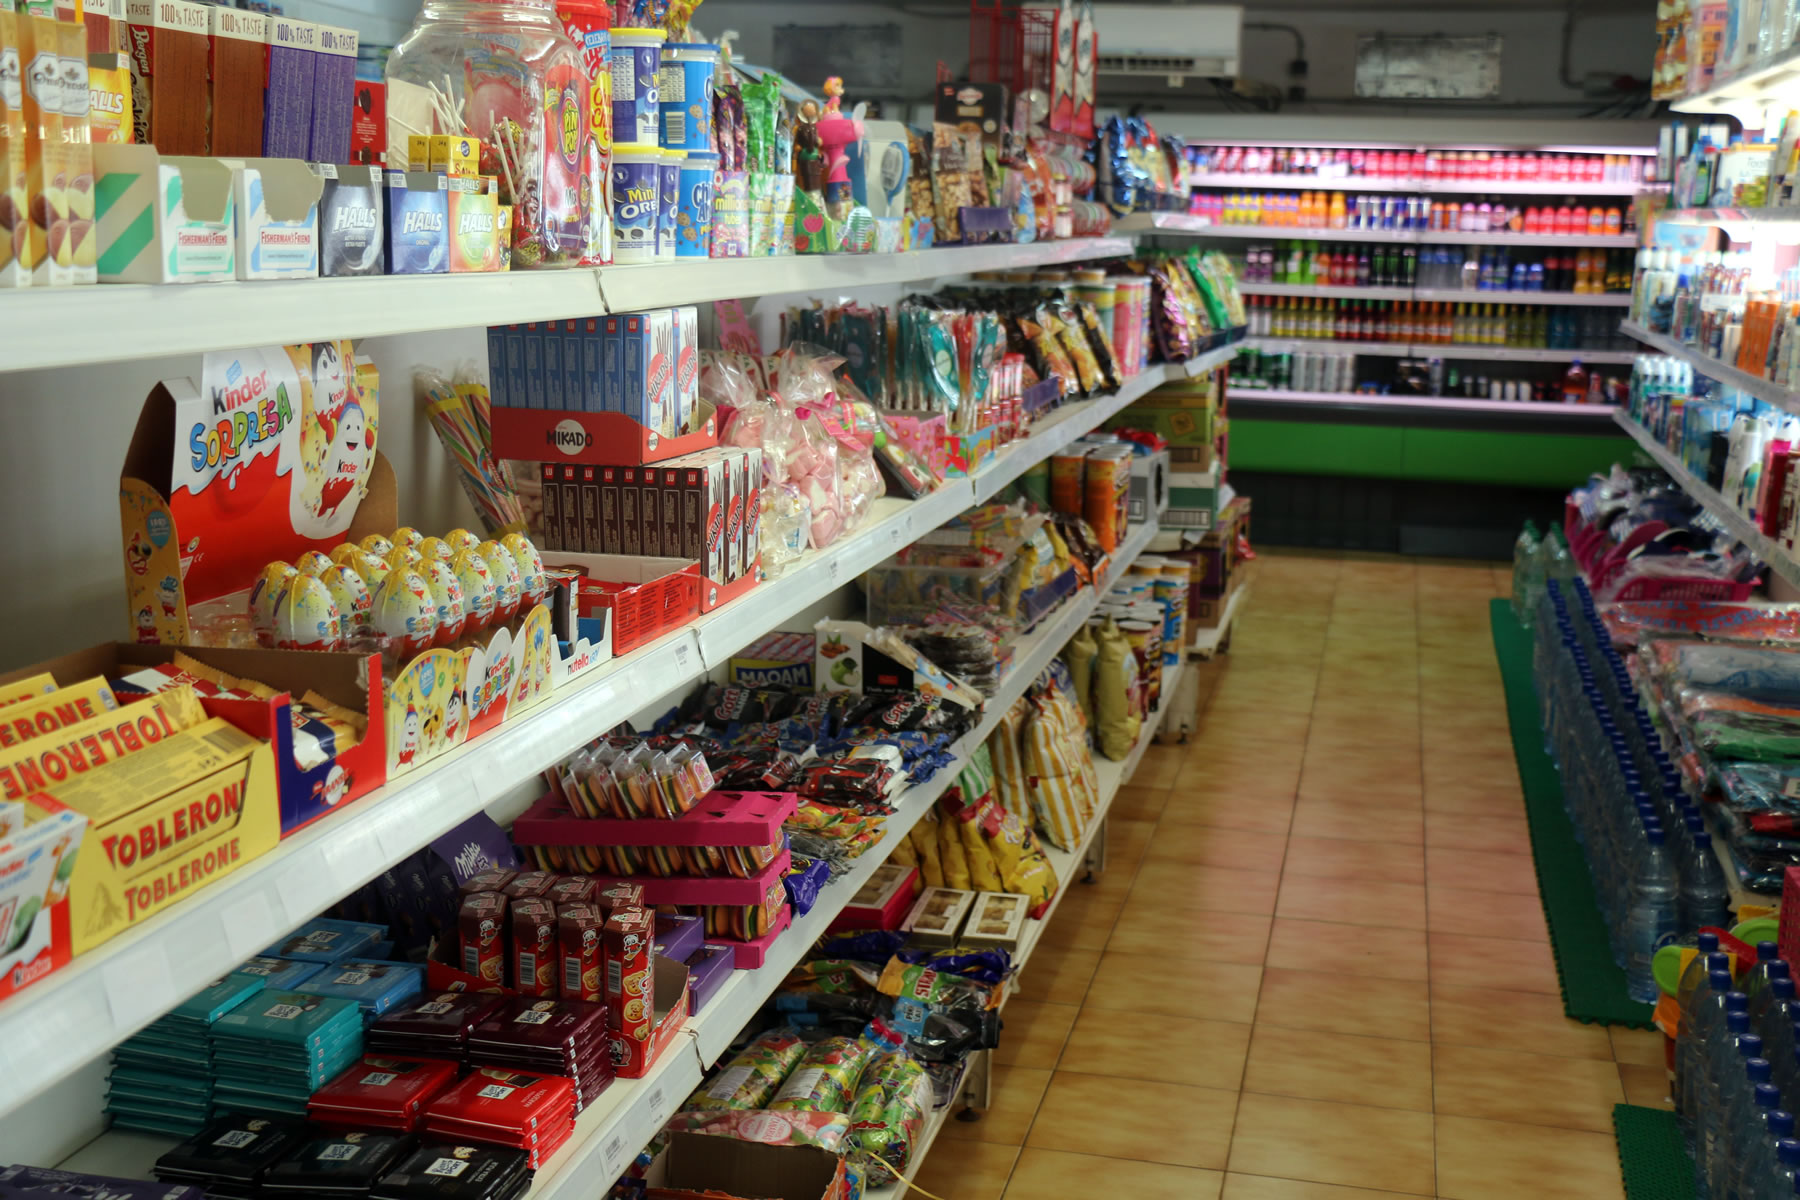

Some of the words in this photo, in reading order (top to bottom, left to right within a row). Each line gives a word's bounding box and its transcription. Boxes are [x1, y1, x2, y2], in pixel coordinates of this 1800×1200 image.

[160, 4, 182, 25] 100%
[184, 6, 205, 27] TASTE
[221, 13, 241, 33] 100%
[242, 15, 262, 35] TASTE
[277, 23, 295, 43] 100%
[296, 25, 314, 45] TASTE
[321, 31, 338, 50] 100%
[339, 33, 356, 51] TASTE
[131, 26, 150, 74] Bergen
[333, 207, 376, 233] HALLS
[403, 211, 443, 234] HALLS
[458, 214, 493, 235] HALLS
[646, 356, 670, 403] MIKADO
[211, 369, 267, 416] Kinder
[190, 381, 293, 473] SORPRESA
[546, 429, 594, 448] MIKADO
[545, 467, 554, 477] LU
[565, 468, 574, 478] LU
[585, 469, 594, 479] LU
[605, 470, 614, 480] LU
[625, 471, 634, 481] LU
[645, 471, 654, 481] LU
[667, 473, 675, 483] LU
[688, 473, 697, 483] LU
[567, 653, 590, 677] nutella
[741, 663, 809, 687] MAOAM
[124, 836, 241, 923] TOBLERONE
